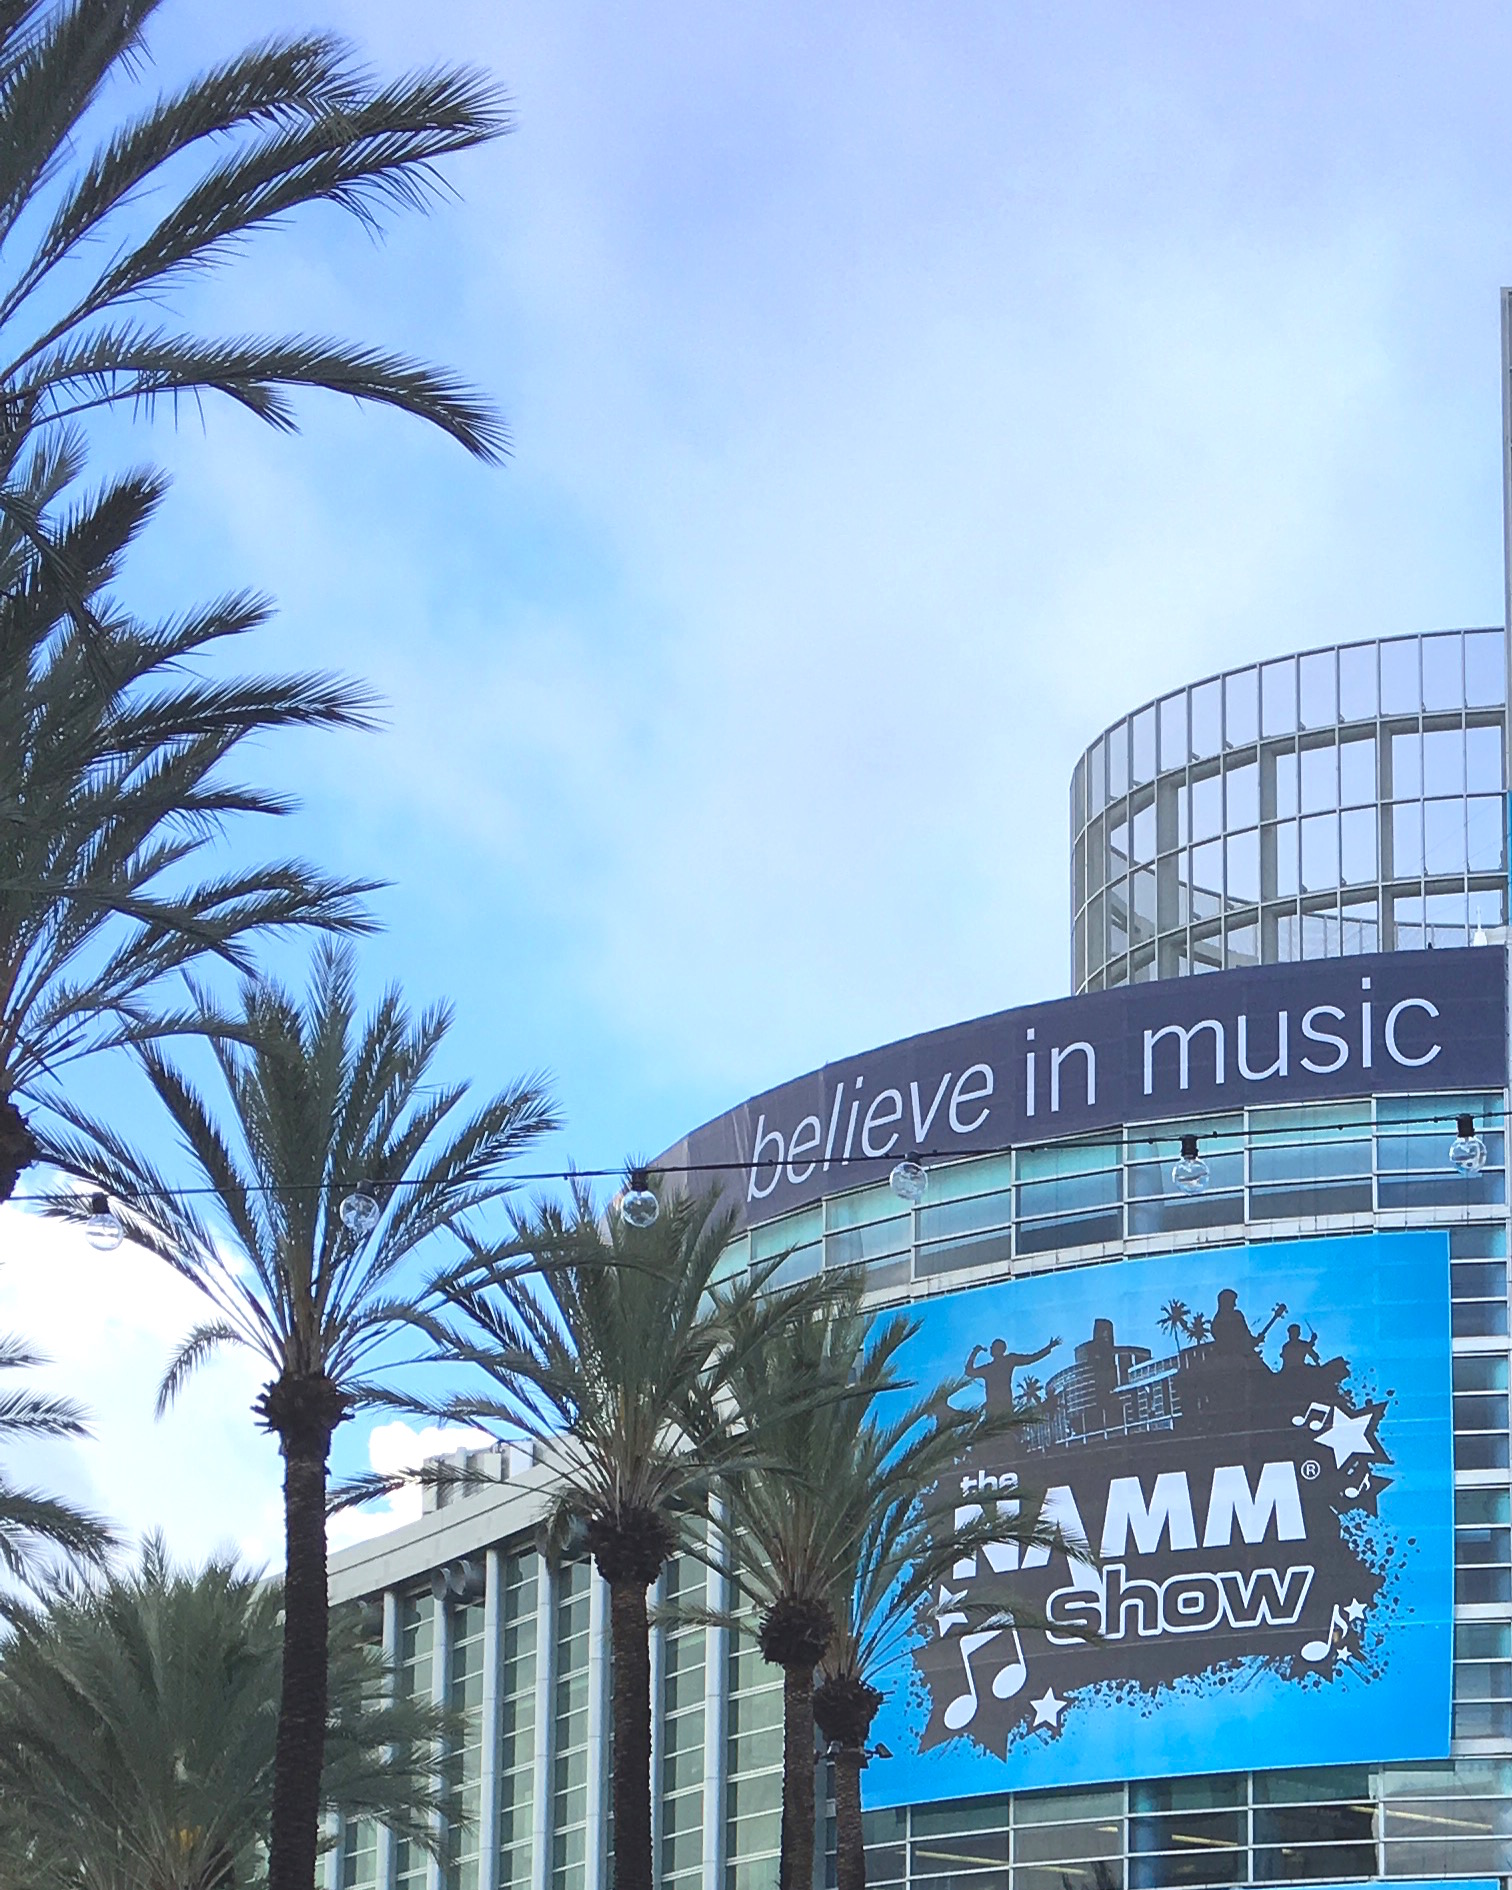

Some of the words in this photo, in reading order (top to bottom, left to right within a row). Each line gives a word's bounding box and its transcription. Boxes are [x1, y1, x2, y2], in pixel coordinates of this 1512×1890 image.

[746, 1062, 995, 1202] believe
[1024, 1027, 1097, 1118] in
[1142, 976, 1442, 1096] music
[960, 1469, 1018, 1496] the
[1045, 1563, 1315, 1645] show
